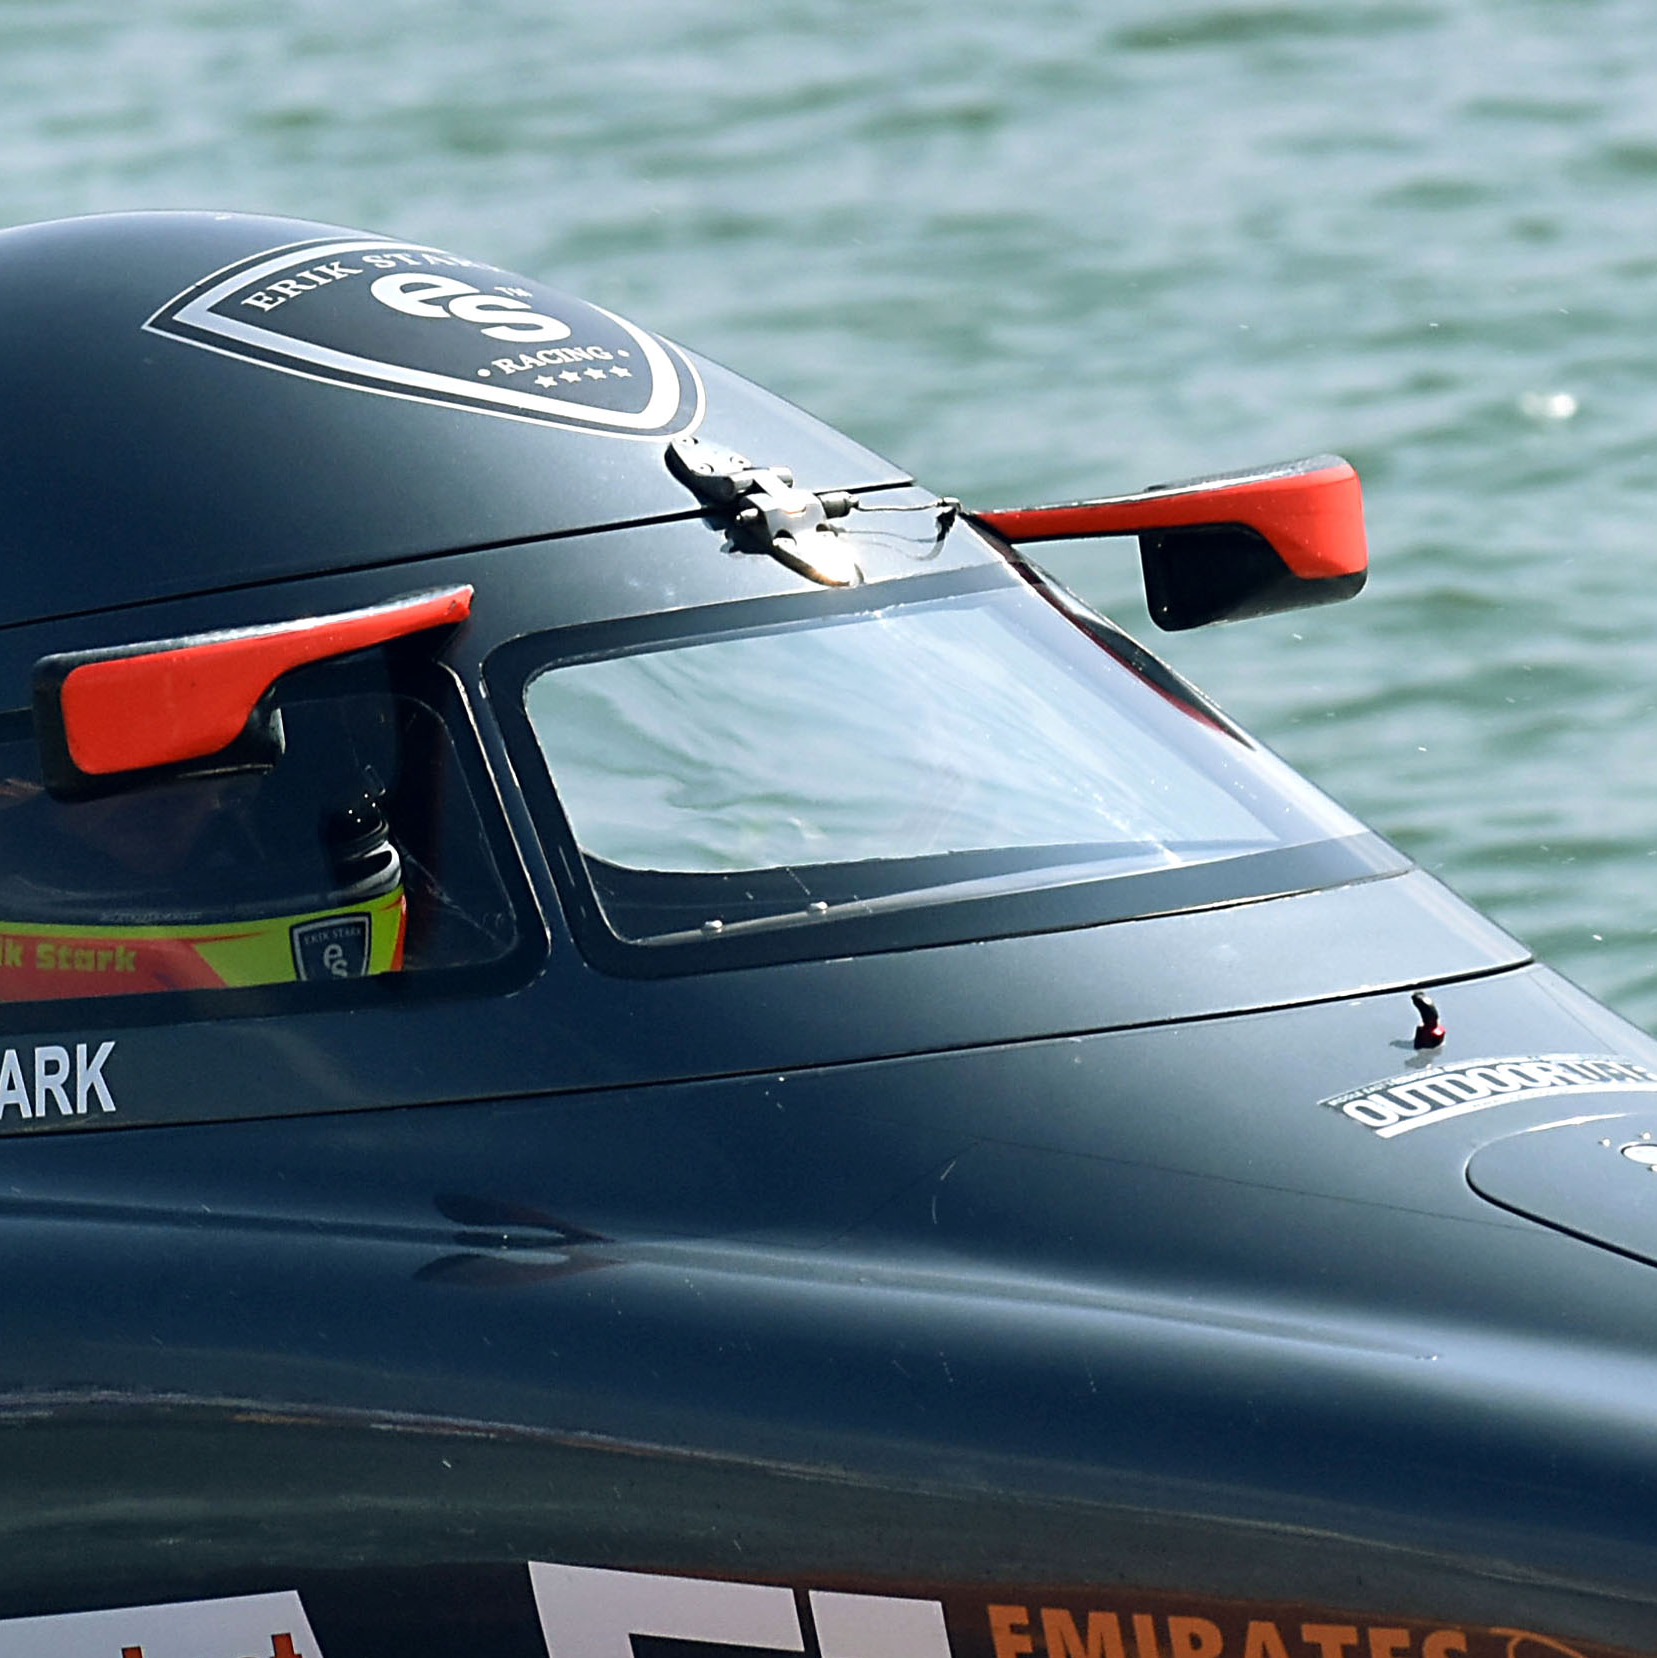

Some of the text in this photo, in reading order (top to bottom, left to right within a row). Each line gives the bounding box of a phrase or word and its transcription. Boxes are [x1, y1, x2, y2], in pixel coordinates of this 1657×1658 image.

[242, 260, 363, 313] ERIK
[492, 344, 614, 376] RACING
[36, 940, 137, 973] Stark
